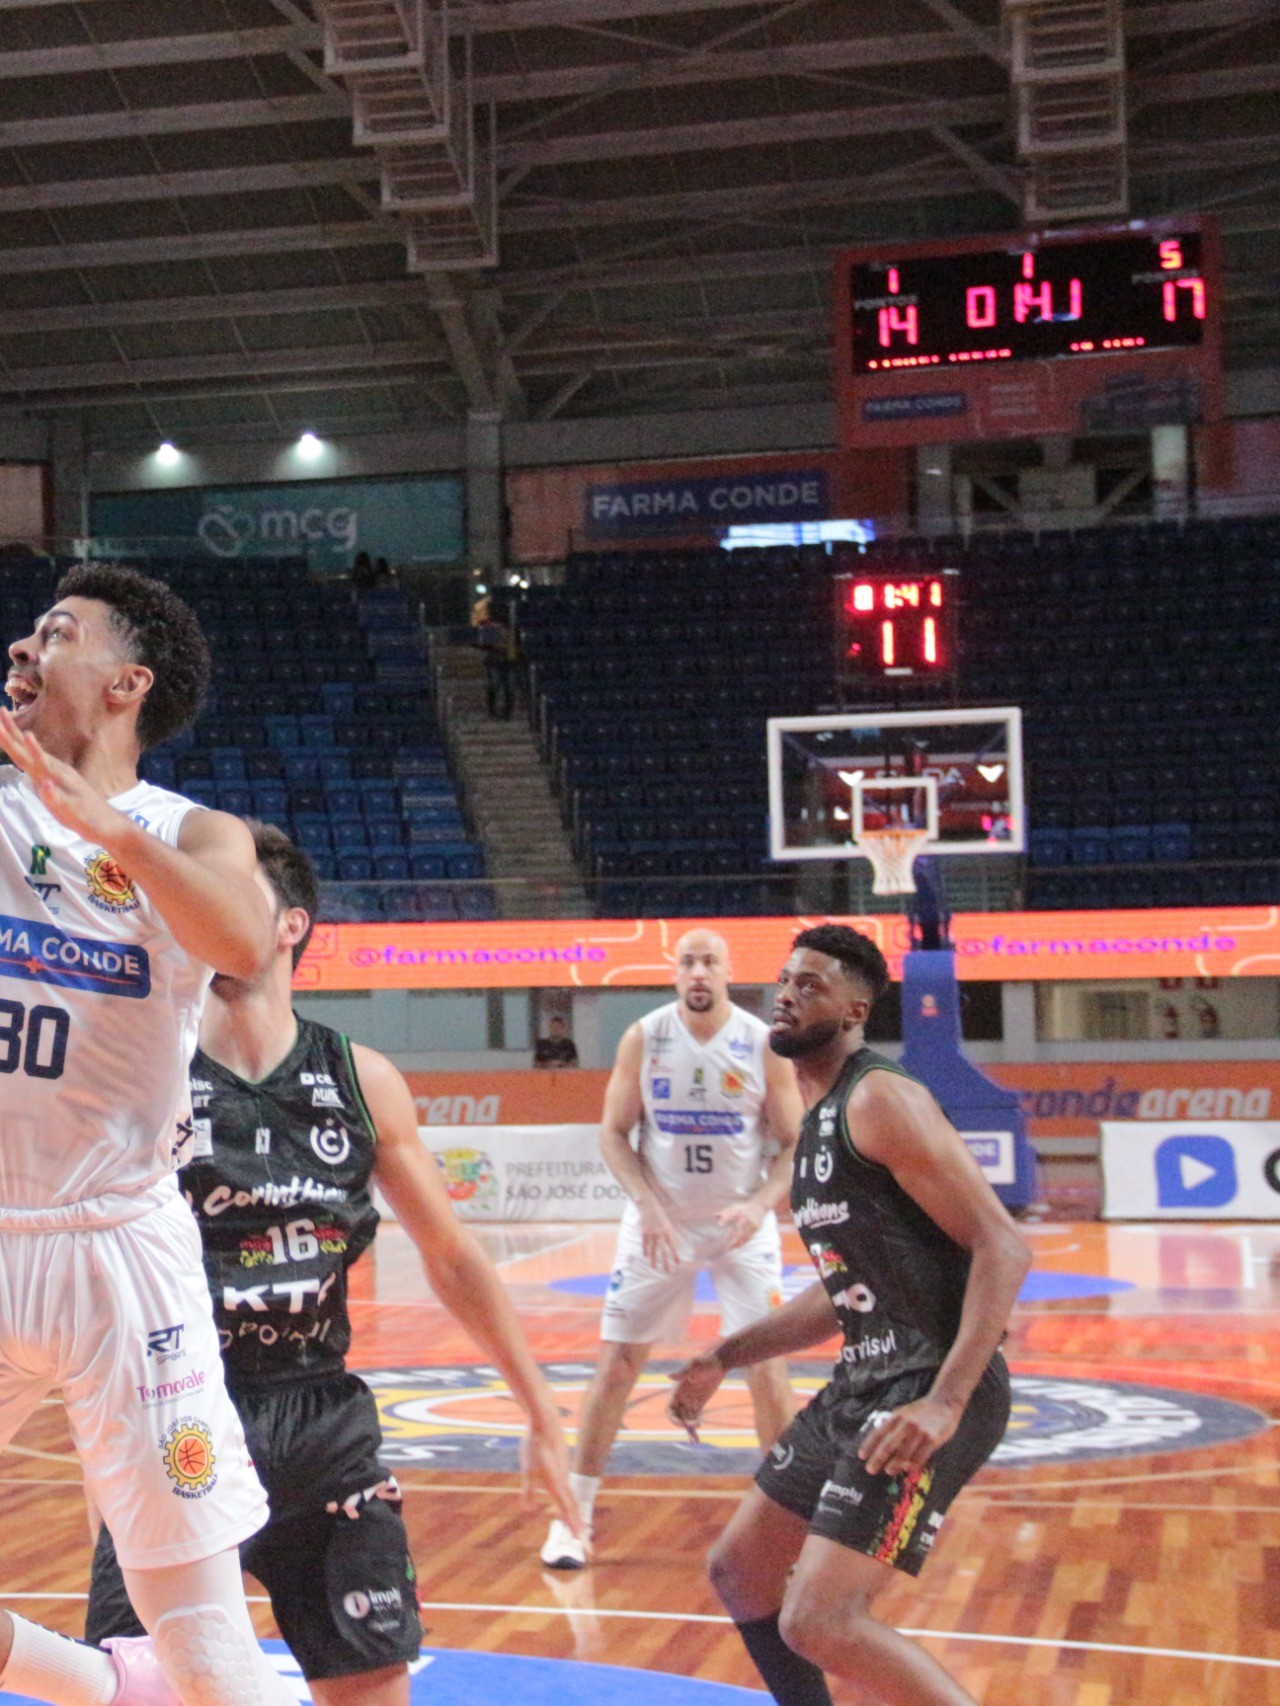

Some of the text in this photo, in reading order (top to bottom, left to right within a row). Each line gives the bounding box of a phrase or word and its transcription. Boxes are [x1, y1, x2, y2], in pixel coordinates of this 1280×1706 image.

[1162, 277, 1206, 322] 17
[592, 480, 820, 520] FARMA CONDE
[260, 506, 358, 553] mcg
[41, 936, 141, 977] CONDE
[349, 944, 607, 969] @farmaconde
[955, 933, 1238, 958] @farmaconde
[413, 1094, 501, 1125] rena
[505, 1161, 607, 1177] PREFEITURA
[684, 1144, 714, 1174] 15
[266, 1217, 320, 1266] 16
[172, 1473, 219, 1500] BASKETBALL
